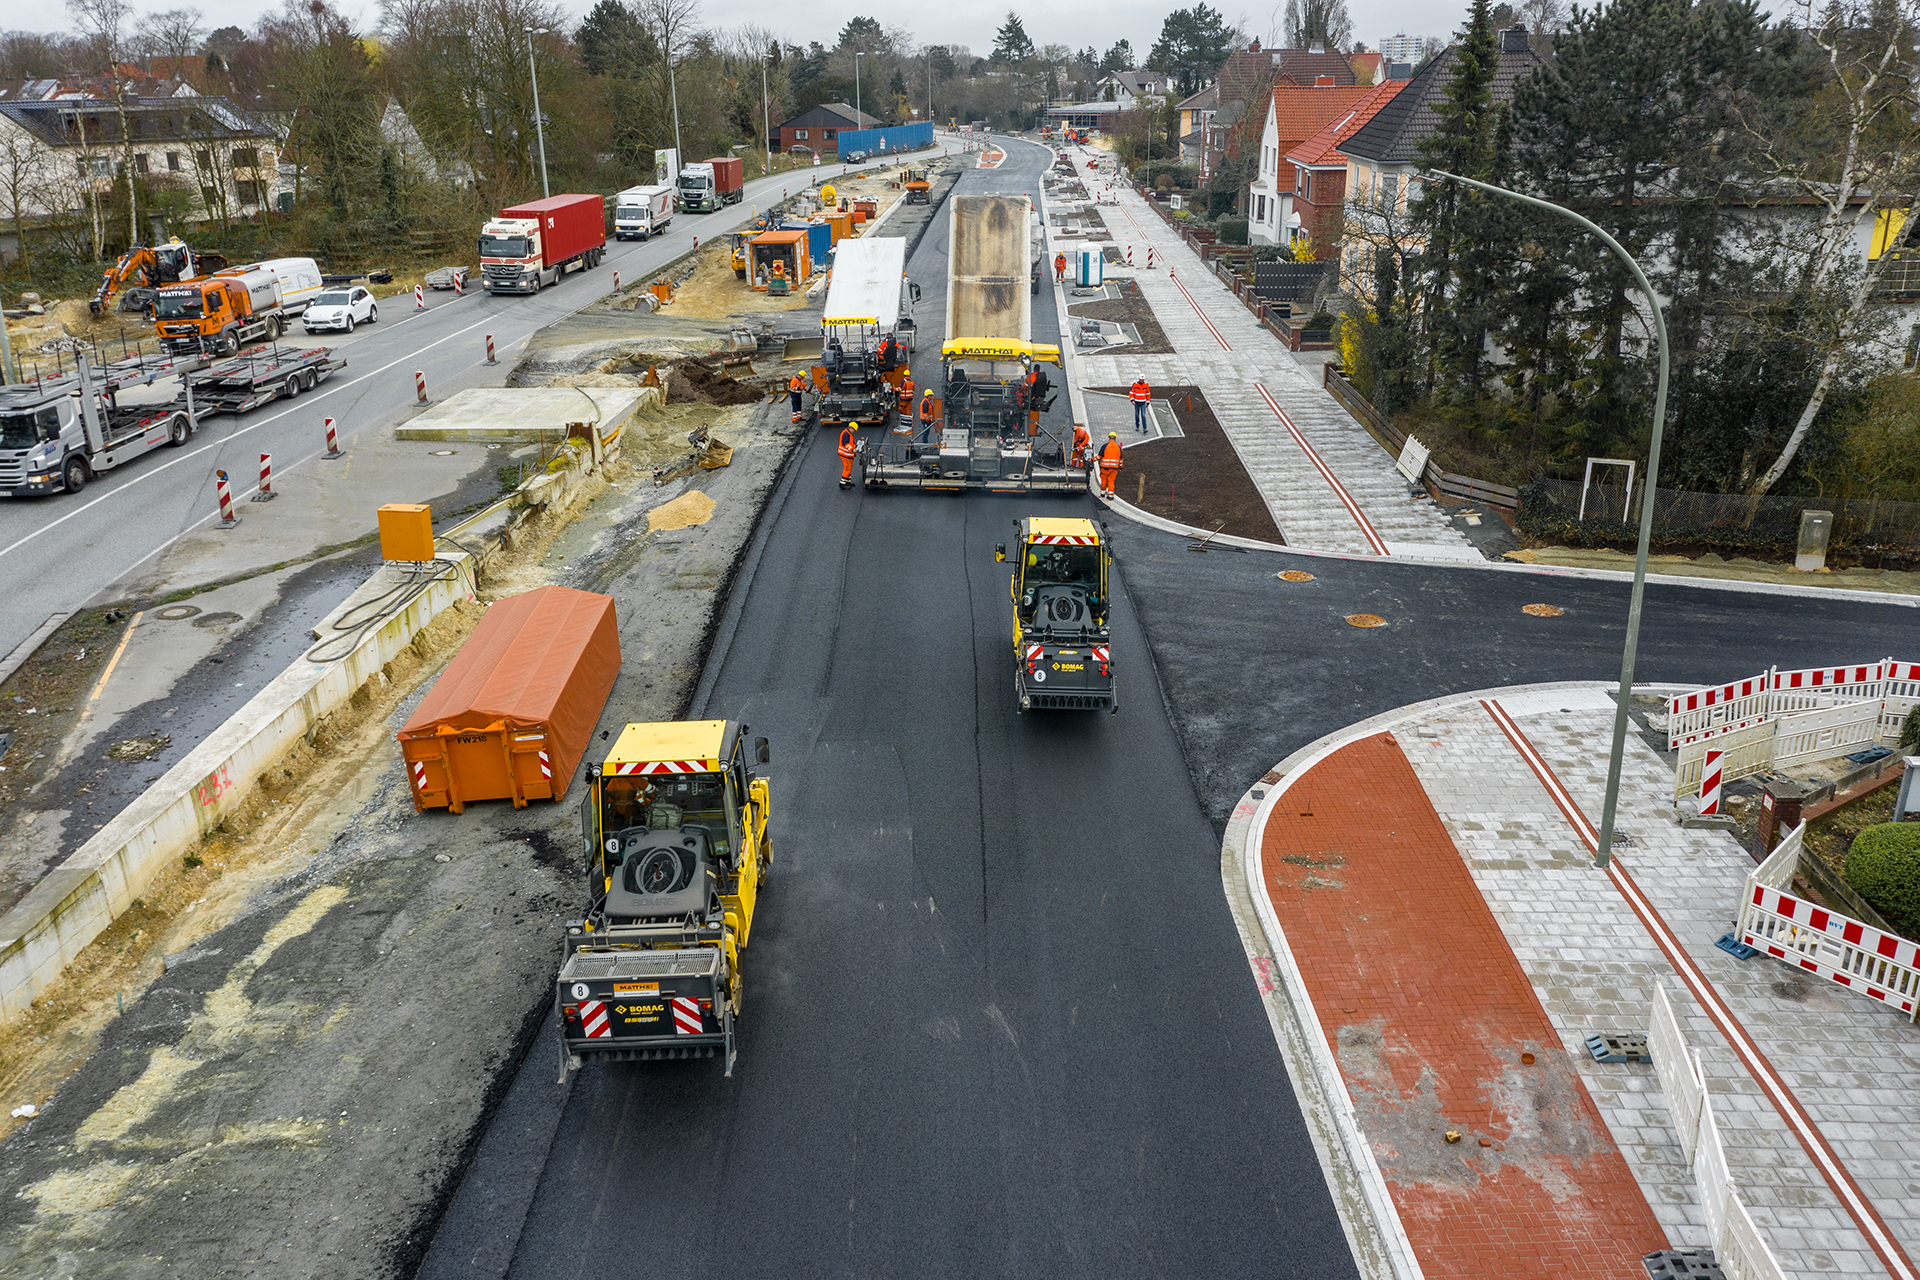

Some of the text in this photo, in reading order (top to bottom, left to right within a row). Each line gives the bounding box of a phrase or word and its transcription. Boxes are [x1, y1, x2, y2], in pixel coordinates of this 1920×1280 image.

[611, 841, 616, 850] 8
[633, 897, 676, 907] BOMAG
[577, 986, 583, 996] 8
[629, 1004, 664, 1012] BOMAG
